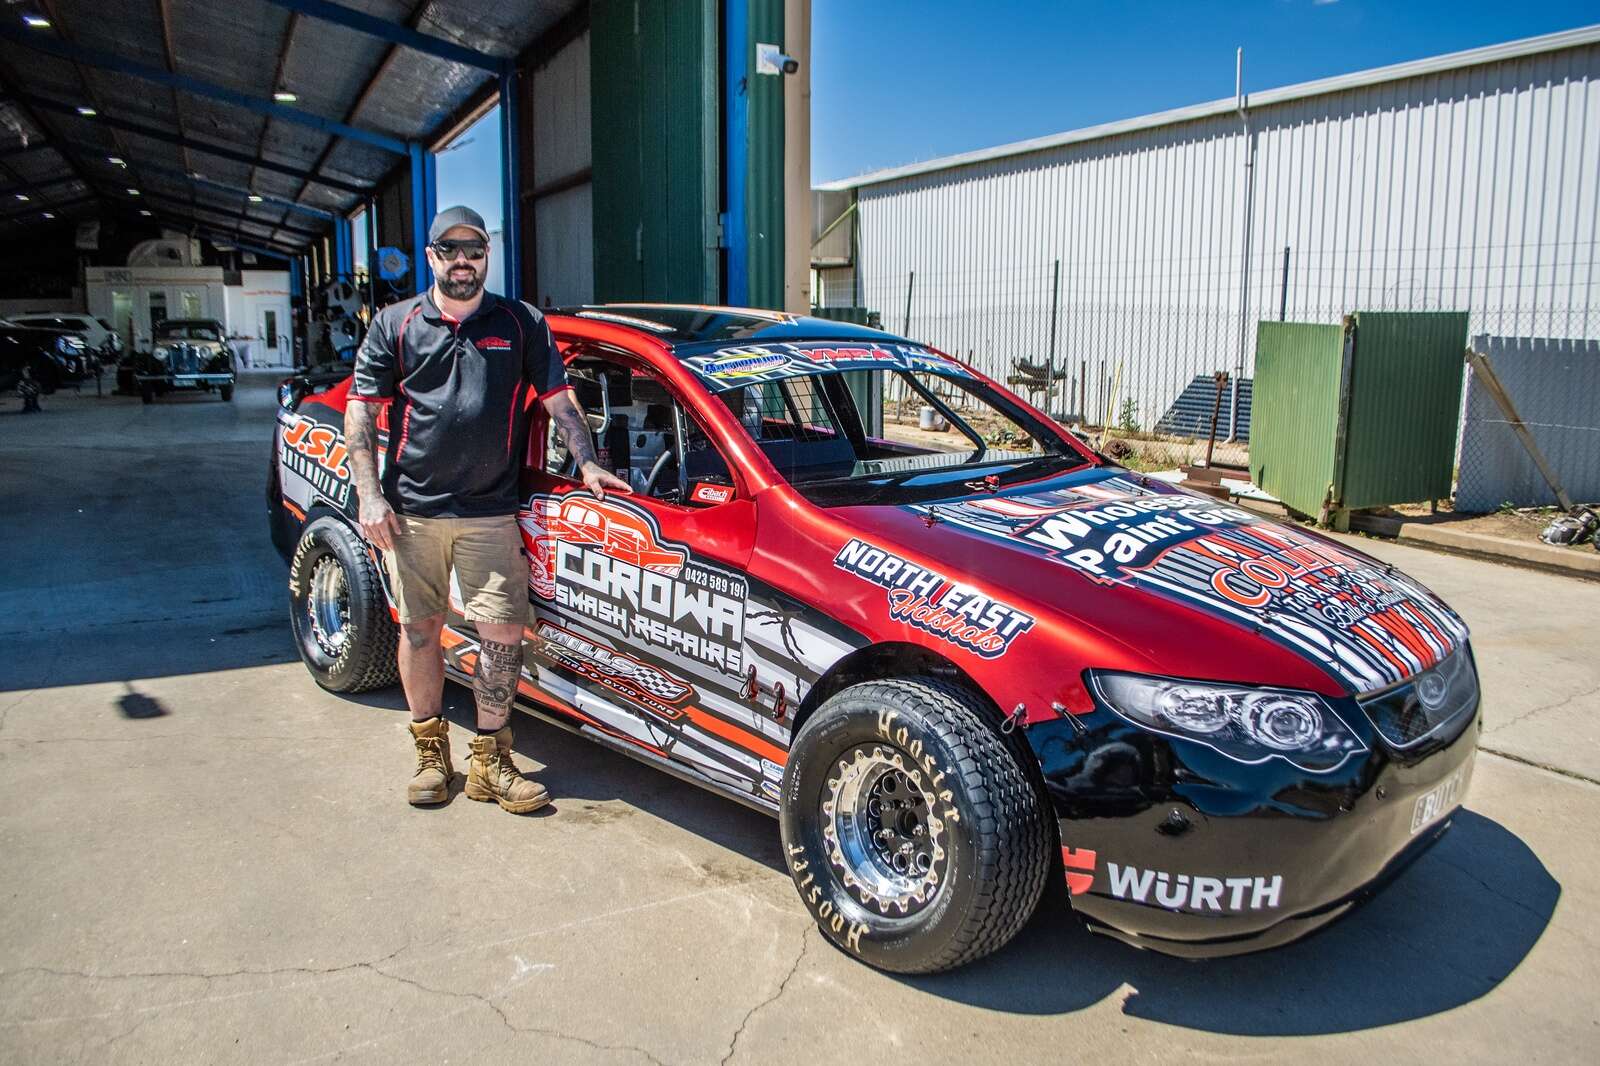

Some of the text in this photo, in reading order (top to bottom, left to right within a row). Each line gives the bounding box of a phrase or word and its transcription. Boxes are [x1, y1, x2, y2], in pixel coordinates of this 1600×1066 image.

[1063, 514, 1196, 575] Paint
[556, 544, 743, 644] COROWA
[685, 567, 708, 587] 0423
[709, 573, 728, 593] 589
[837, 539, 1032, 637] NORTH EAST
[555, 583, 741, 673] SMASH REPAIRS
[889, 588, 1006, 652] Hotshots
[603, 678, 637, 697] DYNO
[642, 696, 675, 716] TUNE
[1106, 861, 1283, 913] WÜRTH
